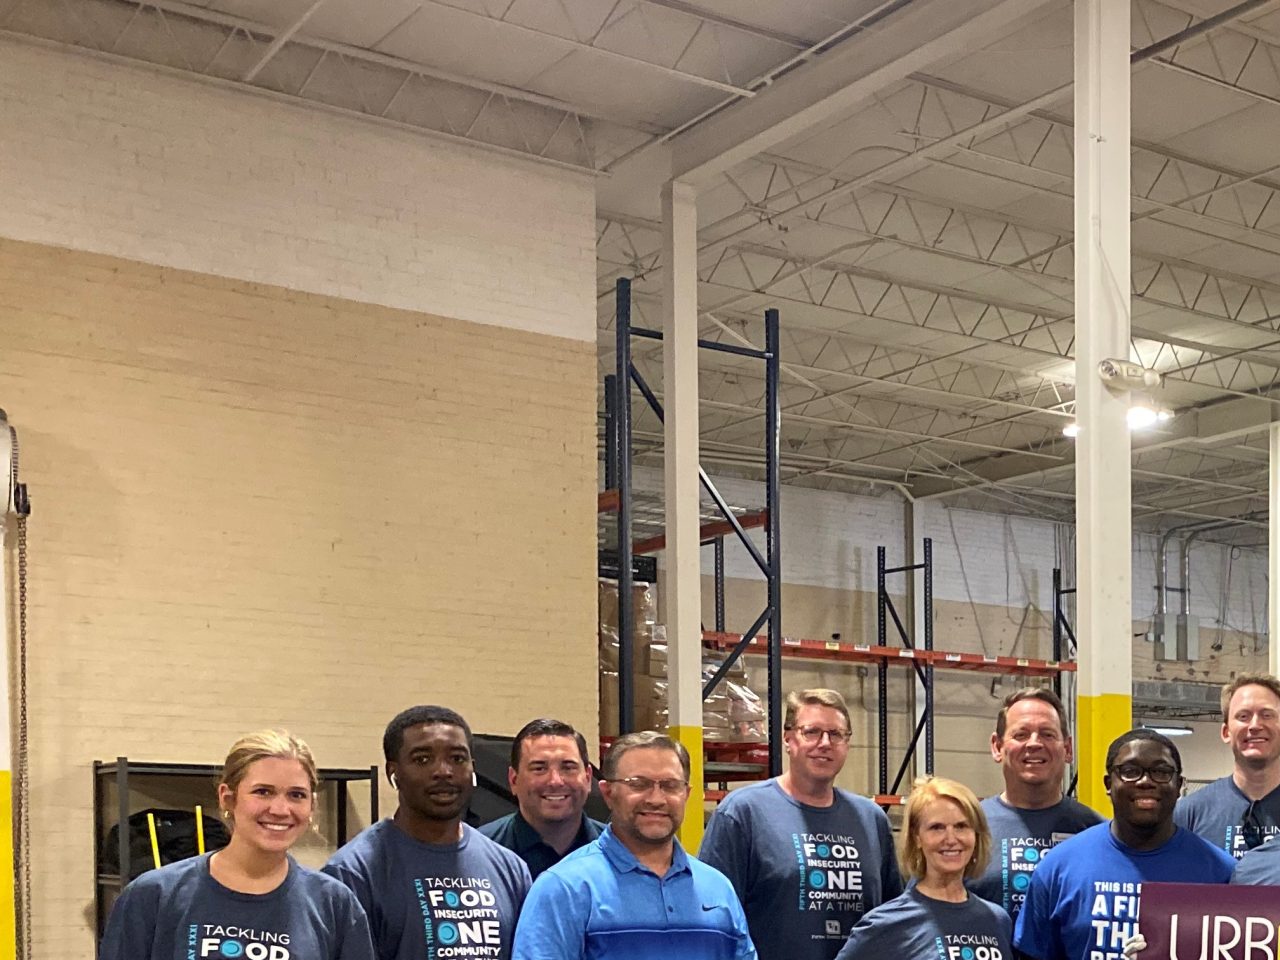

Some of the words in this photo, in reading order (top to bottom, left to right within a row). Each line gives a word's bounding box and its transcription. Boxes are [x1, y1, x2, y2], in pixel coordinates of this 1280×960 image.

[801, 833, 855, 844] TACKLING
[803, 844, 859, 859] FOOD
[807, 859, 861, 868] INSECURITY
[425, 877, 491, 889] TACKLING
[809, 869, 863, 890] ONE
[1094, 881, 1121, 893] THIS
[1122, 882, 1135, 894] IS
[415, 879, 425, 898] XXXI
[808, 891, 863, 900] COMMUNITY
[428, 889, 496, 908] FOOD
[809, 901, 823, 911] AT
[826, 901, 835, 911] A
[838, 902, 864, 911] TIME
[1091, 894, 1109, 916] A
[419, 899, 430, 916] DAY
[434, 908, 498, 919] INSECURITY
[189, 924, 198, 946] XXXI
[203, 924, 290, 945] TACKLING
[424, 918, 434, 945] THIRD
[437, 920, 501, 945] ONE
[945, 934, 999, 945] TACKLING
